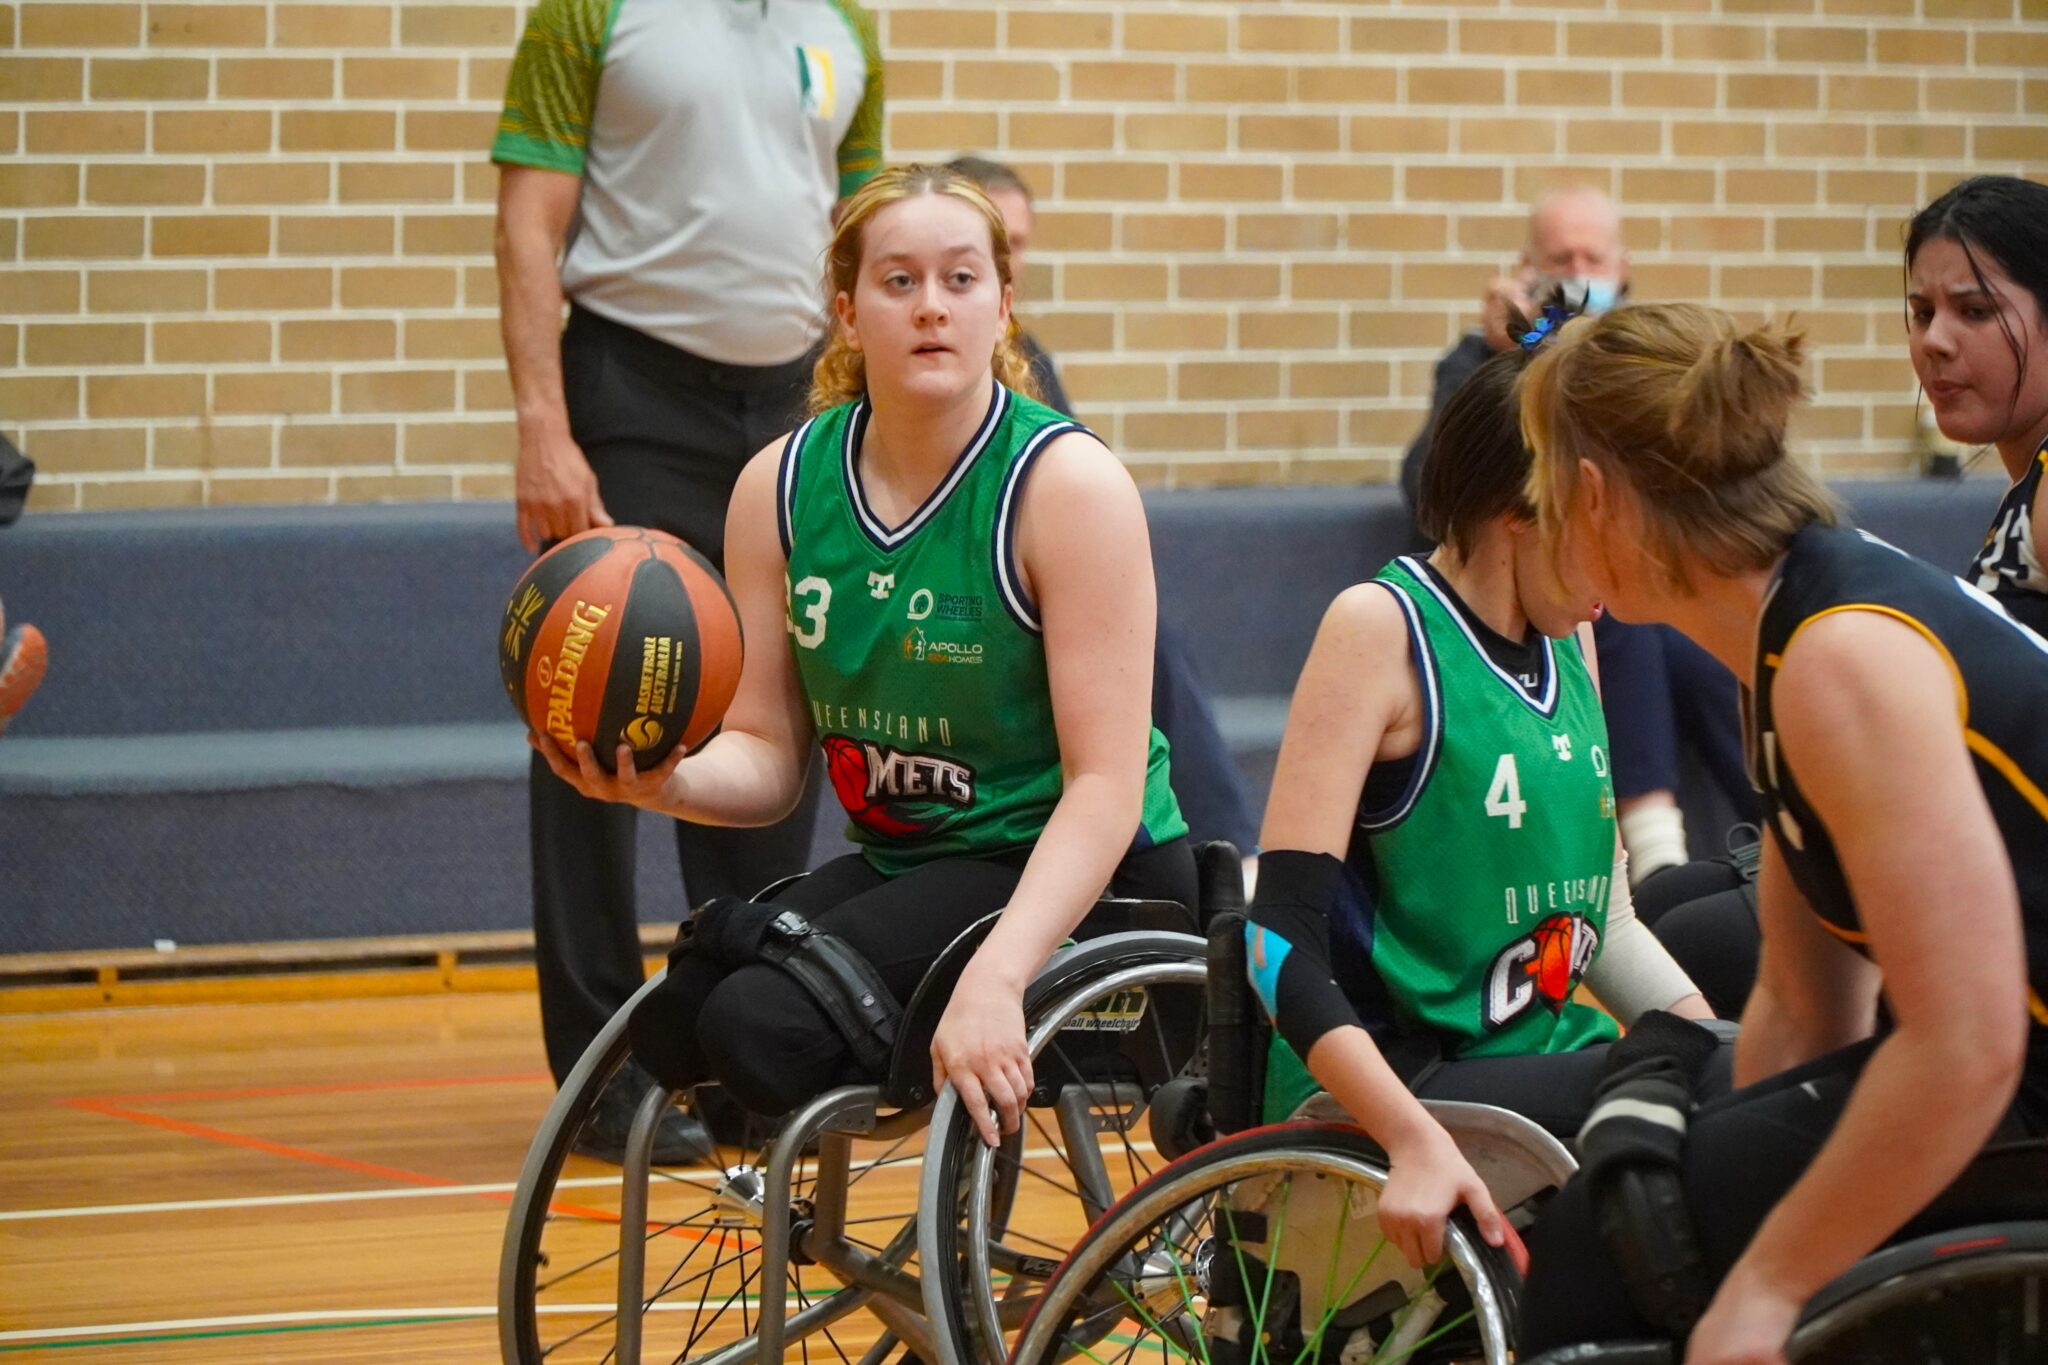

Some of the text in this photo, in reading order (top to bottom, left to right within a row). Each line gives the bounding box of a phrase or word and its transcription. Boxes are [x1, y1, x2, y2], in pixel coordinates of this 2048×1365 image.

[785, 572, 832, 650] 3
[928, 642, 983, 654] APOLLO
[547, 599, 610, 747] SPALDING
[635, 636, 657, 714] BASKETBALL
[649, 636, 671, 715] AUSTRALIA
[813, 701, 952, 746] UEENSLAND
[1484, 753, 1527, 829] 4
